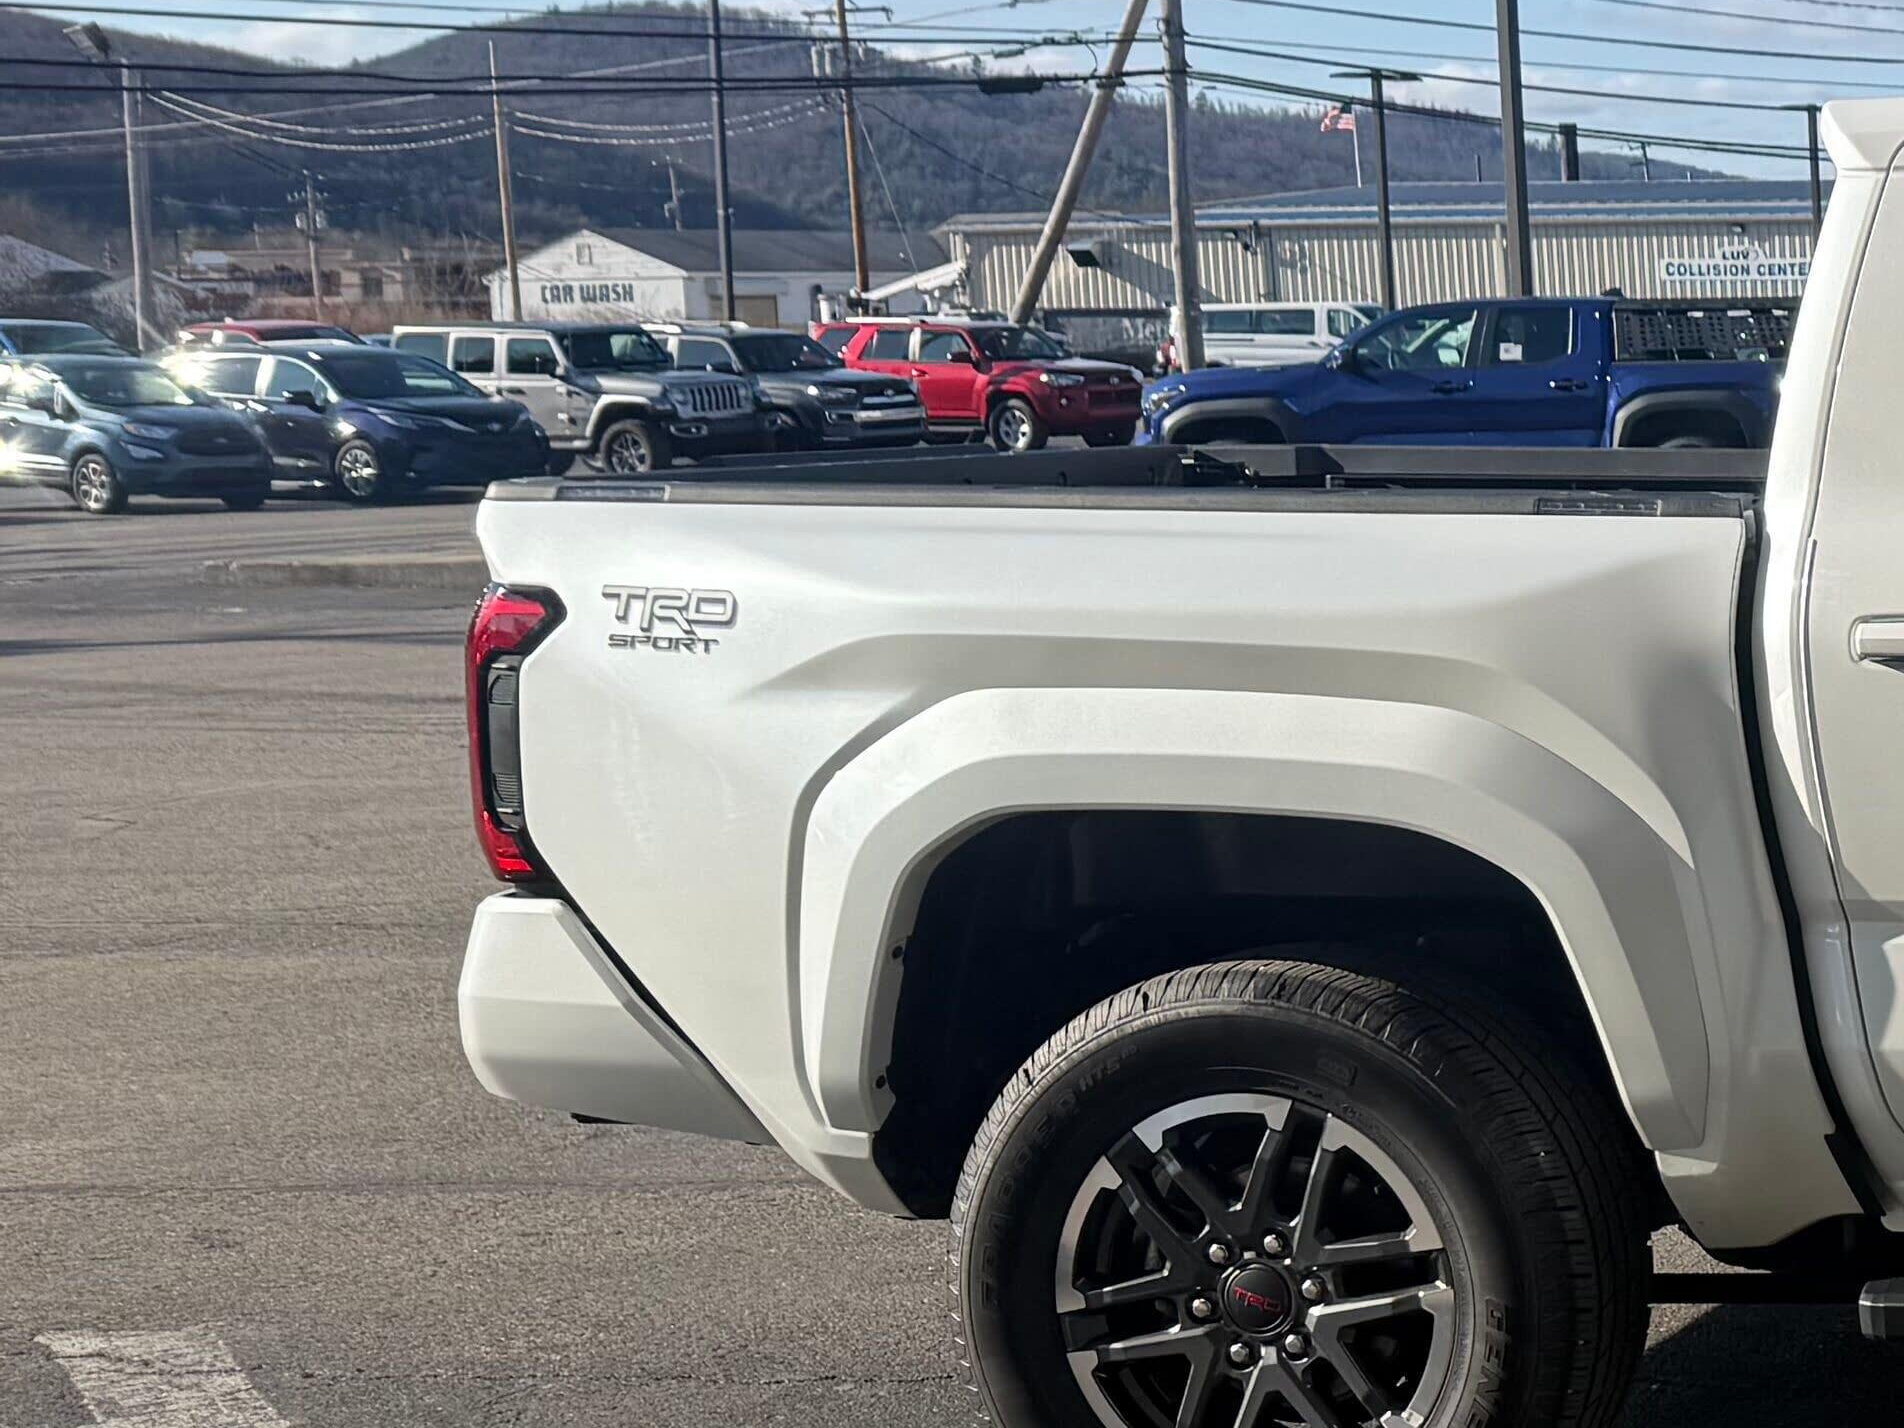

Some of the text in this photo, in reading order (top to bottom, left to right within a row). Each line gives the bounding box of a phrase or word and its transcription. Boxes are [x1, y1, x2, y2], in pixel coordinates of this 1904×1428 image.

[1665, 262, 1751, 276] COLLISION
[541, 283, 634, 304] CAR WASH
[602, 584, 737, 635] TRD
[608, 634, 720, 654] SPORT
[1233, 1284, 1280, 1312] TRD
